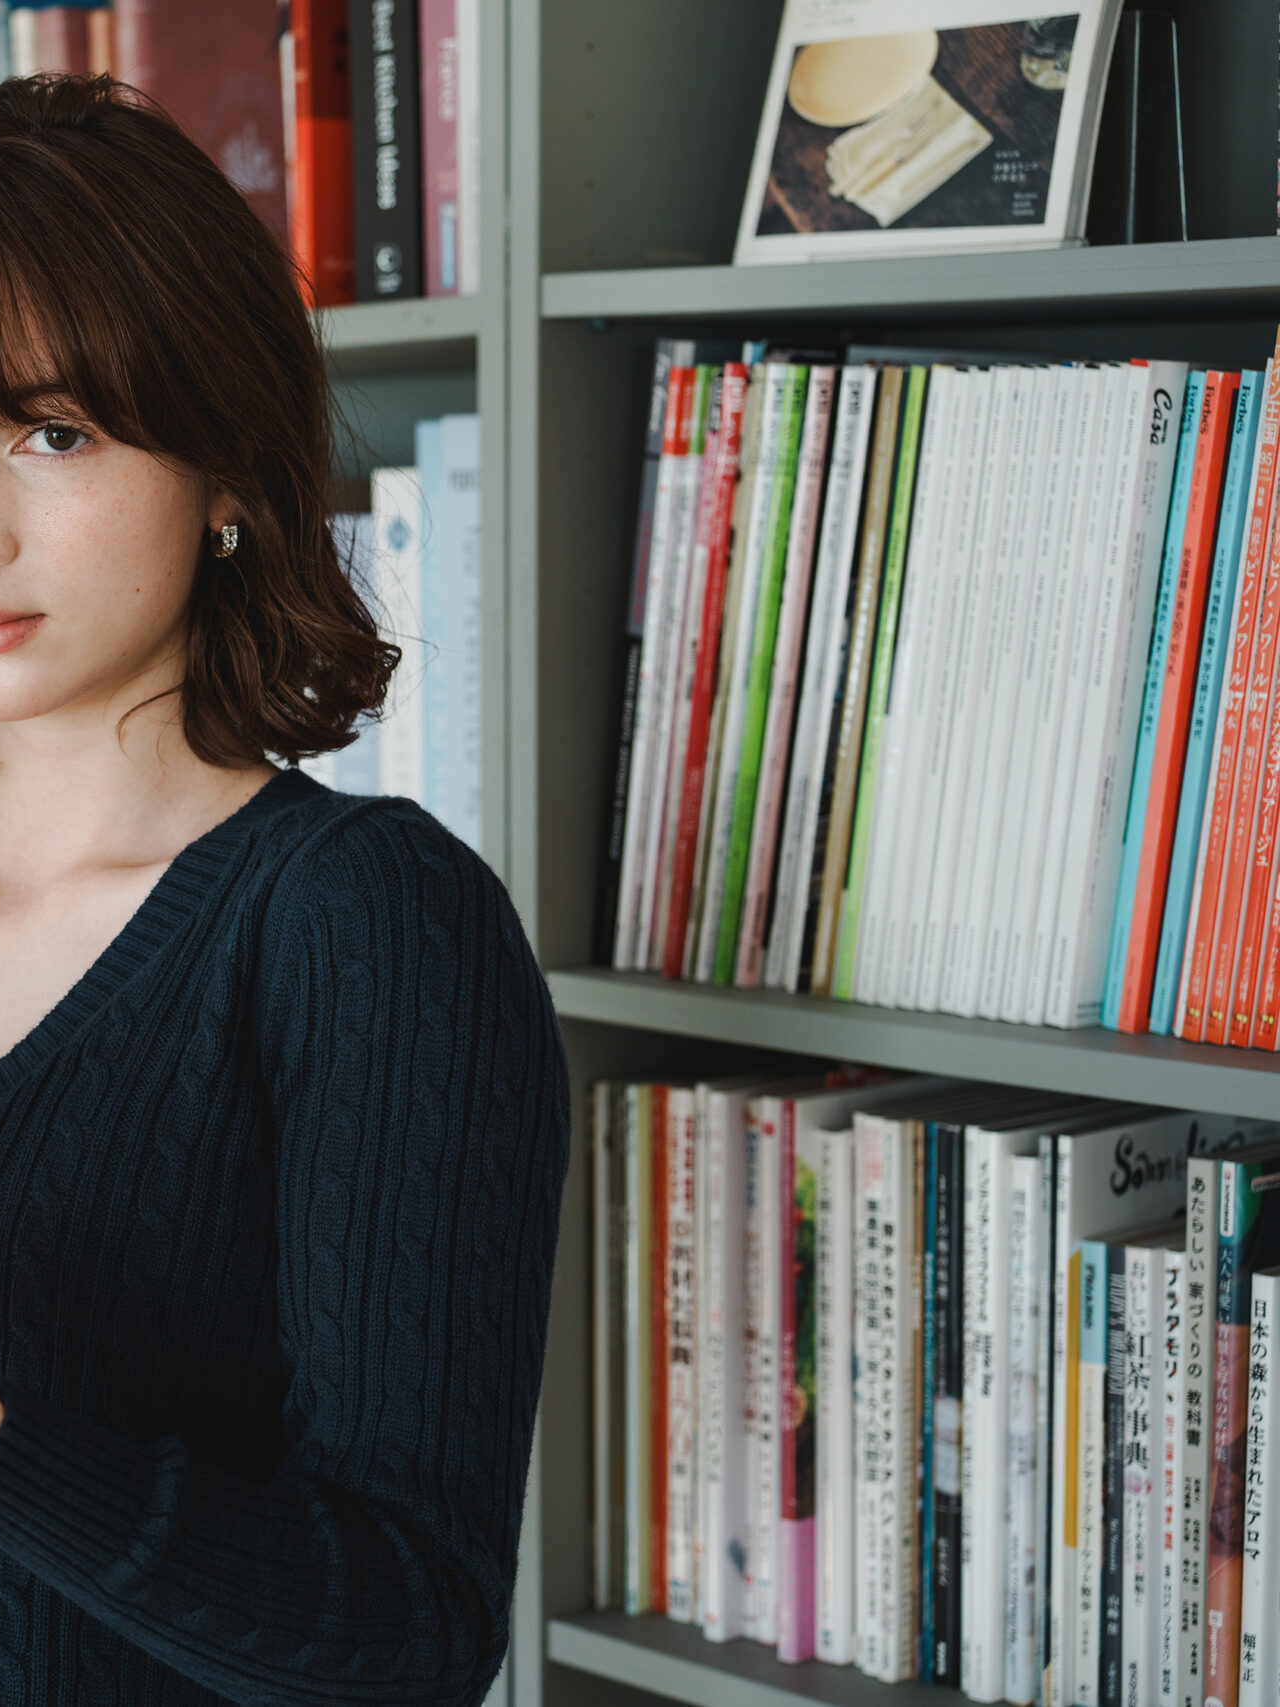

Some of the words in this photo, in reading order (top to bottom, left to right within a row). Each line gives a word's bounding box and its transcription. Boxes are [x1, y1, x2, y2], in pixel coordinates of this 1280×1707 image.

[1150, 387, 1172, 446] Casa
[1182, 384, 1199, 434] Forbes
[1199, 384, 1215, 435] Forbes
[1235, 384, 1251, 435] Forbes
[1188, 1177, 1205, 1272] あたらしい
[1187, 1282, 1205, 1379] 家づくりの
[1185, 1389, 1202, 1447] 教科書
[1245, 1300, 1268, 1561] 日本の森から生まれたアロマ
